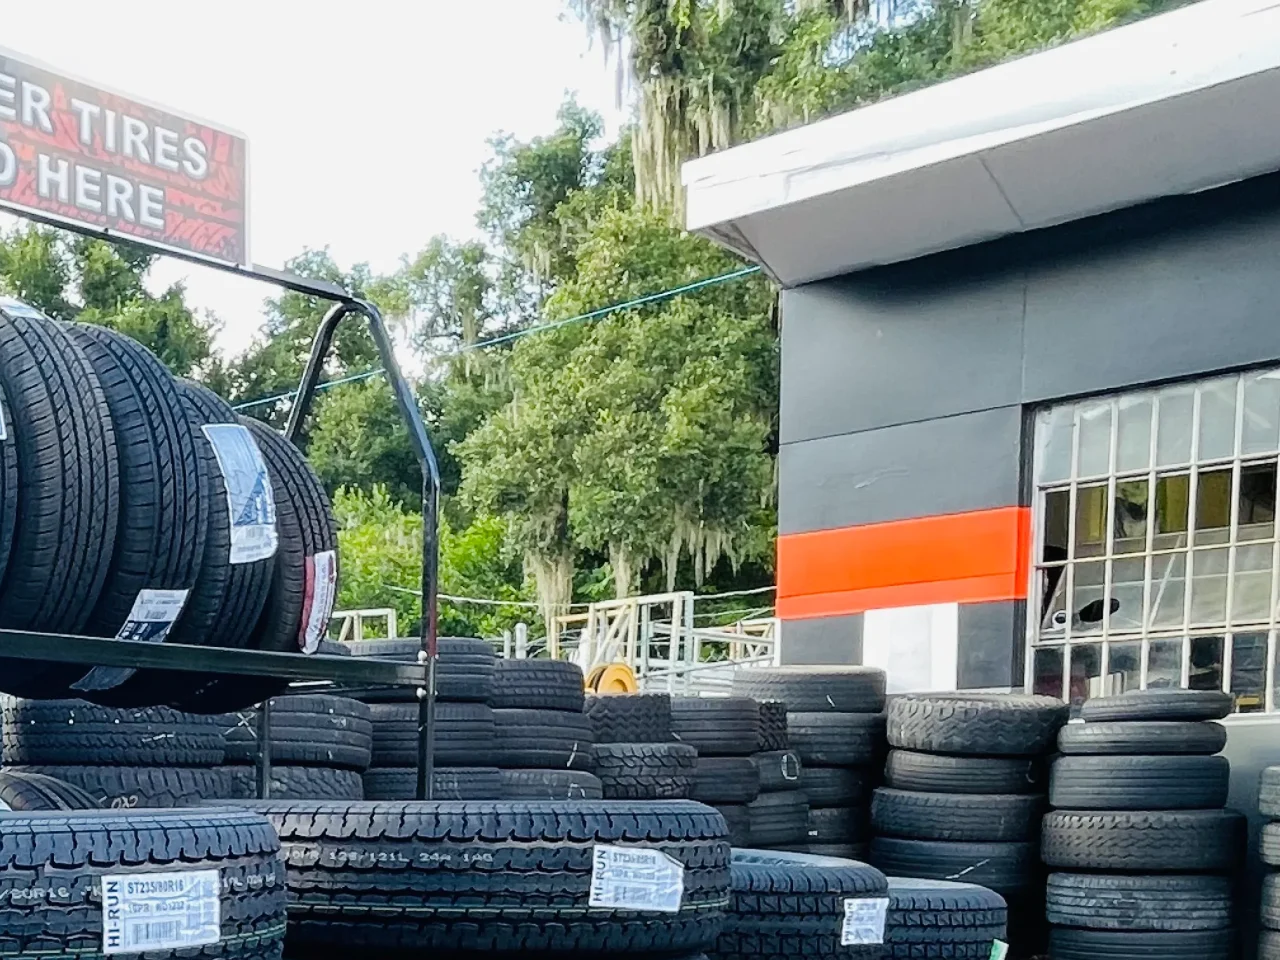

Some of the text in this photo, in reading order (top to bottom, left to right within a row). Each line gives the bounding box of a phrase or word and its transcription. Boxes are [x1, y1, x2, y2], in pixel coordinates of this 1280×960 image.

[72, 99, 208, 180] TIRES
[36, 153, 166, 230] HERE
[593, 849, 606, 901] HI-RUN
[107, 881, 120, 947] HI-RUN
